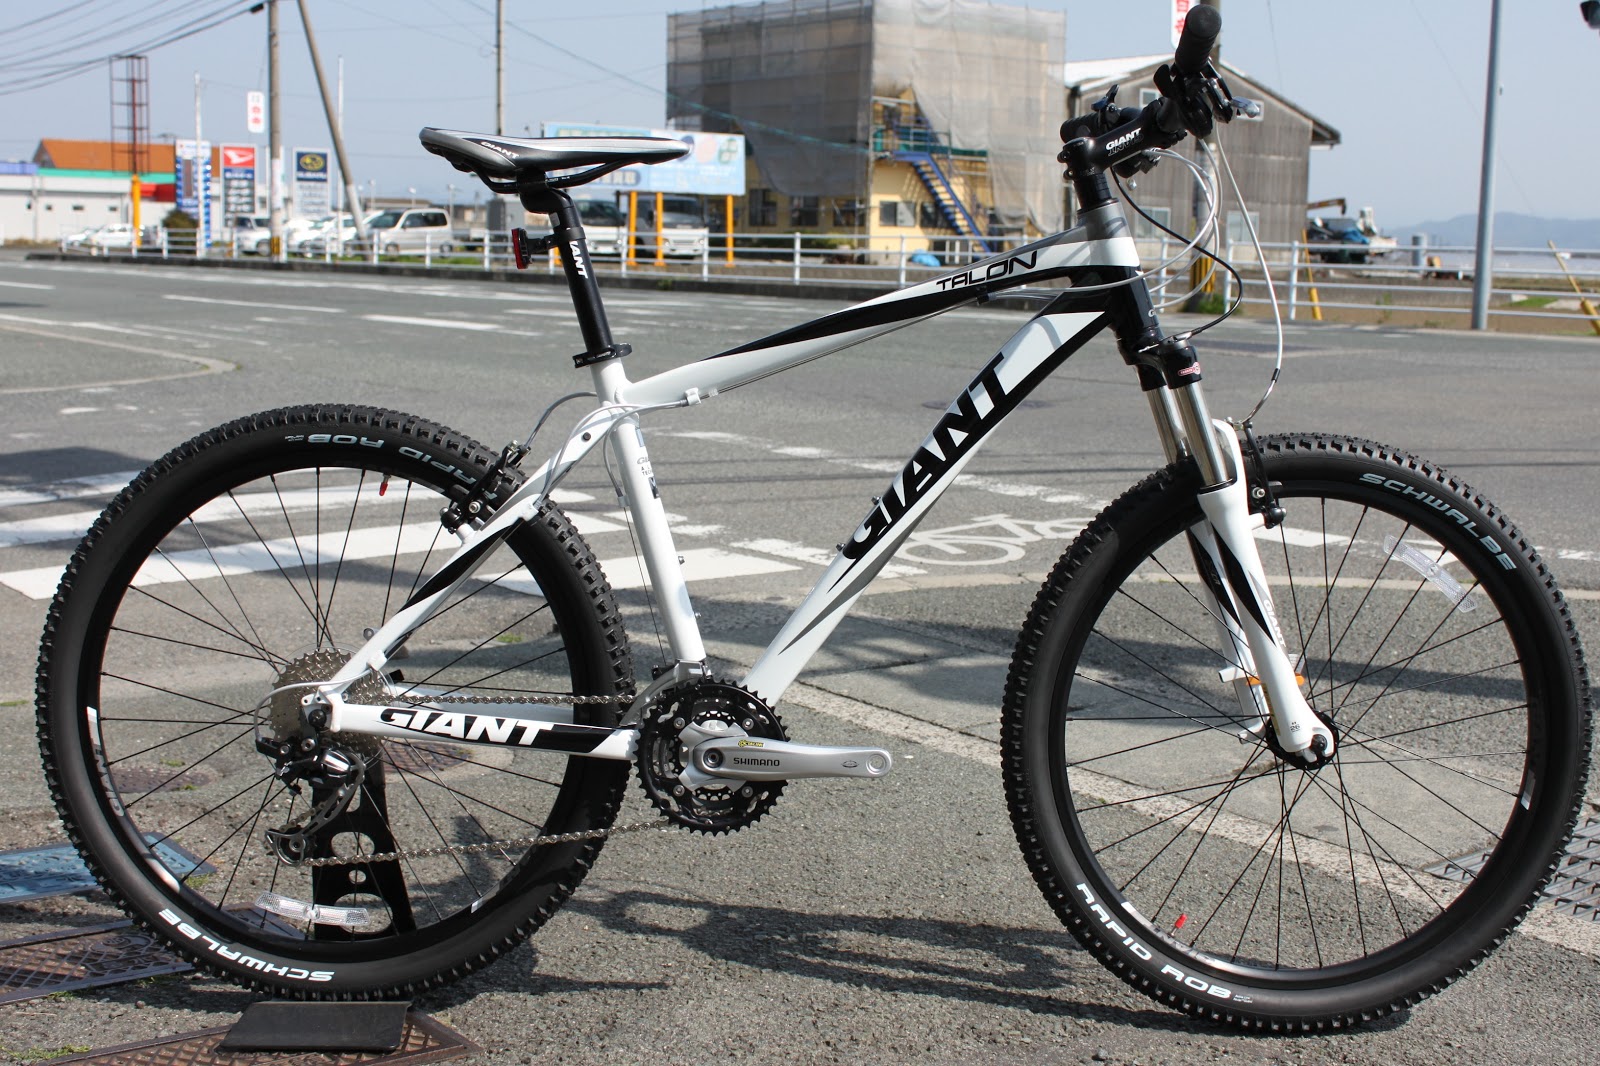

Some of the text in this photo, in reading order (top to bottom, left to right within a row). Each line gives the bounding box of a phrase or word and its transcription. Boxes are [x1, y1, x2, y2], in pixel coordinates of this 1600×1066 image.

[480, 141, 520, 159] GIANT
[1105, 127, 1142, 150] GIANT
[566, 228, 589, 279] IANT
[935, 250, 1038, 290] TALON
[308, 433, 385, 449] ROB
[842, 351, 1008, 560] GIANT
[1359, 472, 1518, 571] SCHWALBE
[1263, 599, 1287, 648] GIANT
[378, 707, 555, 747] GIANT
[733, 757, 781, 767] SHIMANO
[158, 908, 335, 982] SCHWALBE
[1076, 882, 1232, 999] RAPID ROB
